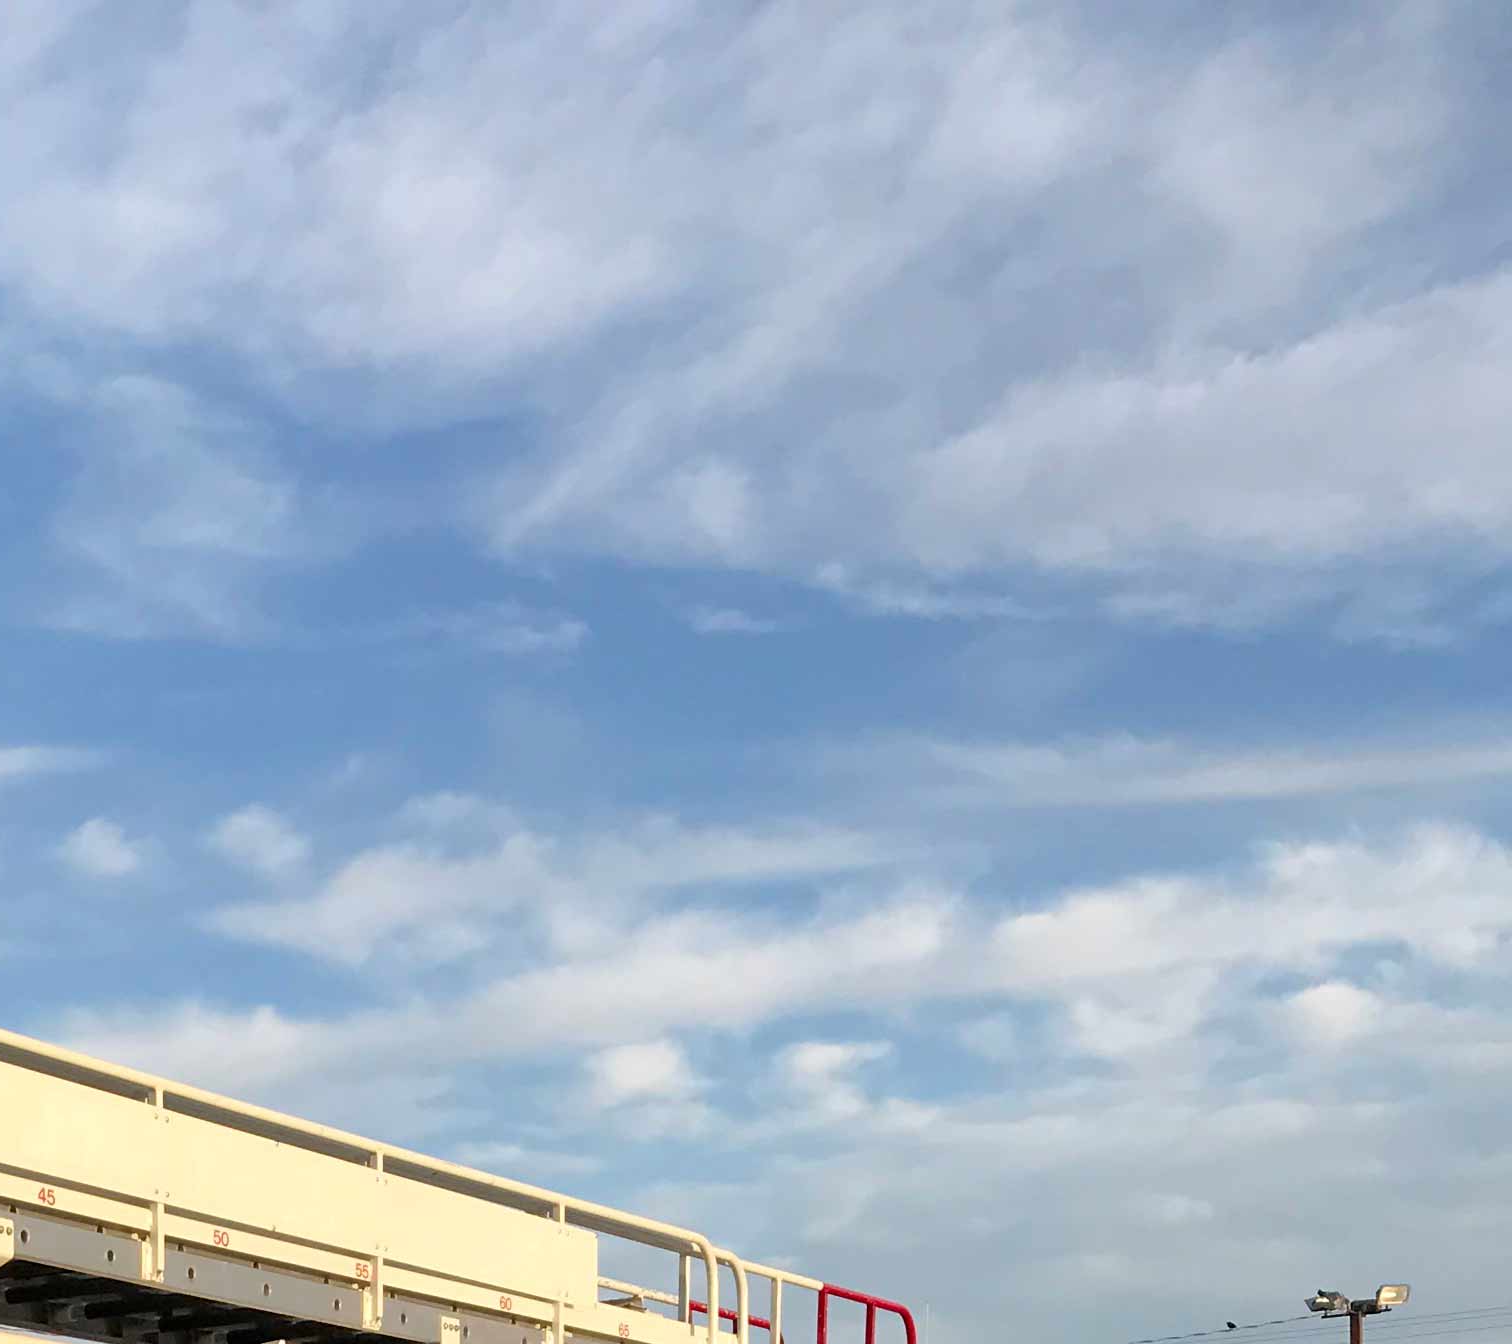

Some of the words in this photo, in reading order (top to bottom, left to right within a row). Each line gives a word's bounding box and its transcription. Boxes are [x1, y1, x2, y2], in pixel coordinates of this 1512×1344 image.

[37, 1186, 56, 1206] 45
[213, 1229, 230, 1247] 50
[355, 1262, 369, 1279] 55
[499, 1295, 512, 1311] 60
